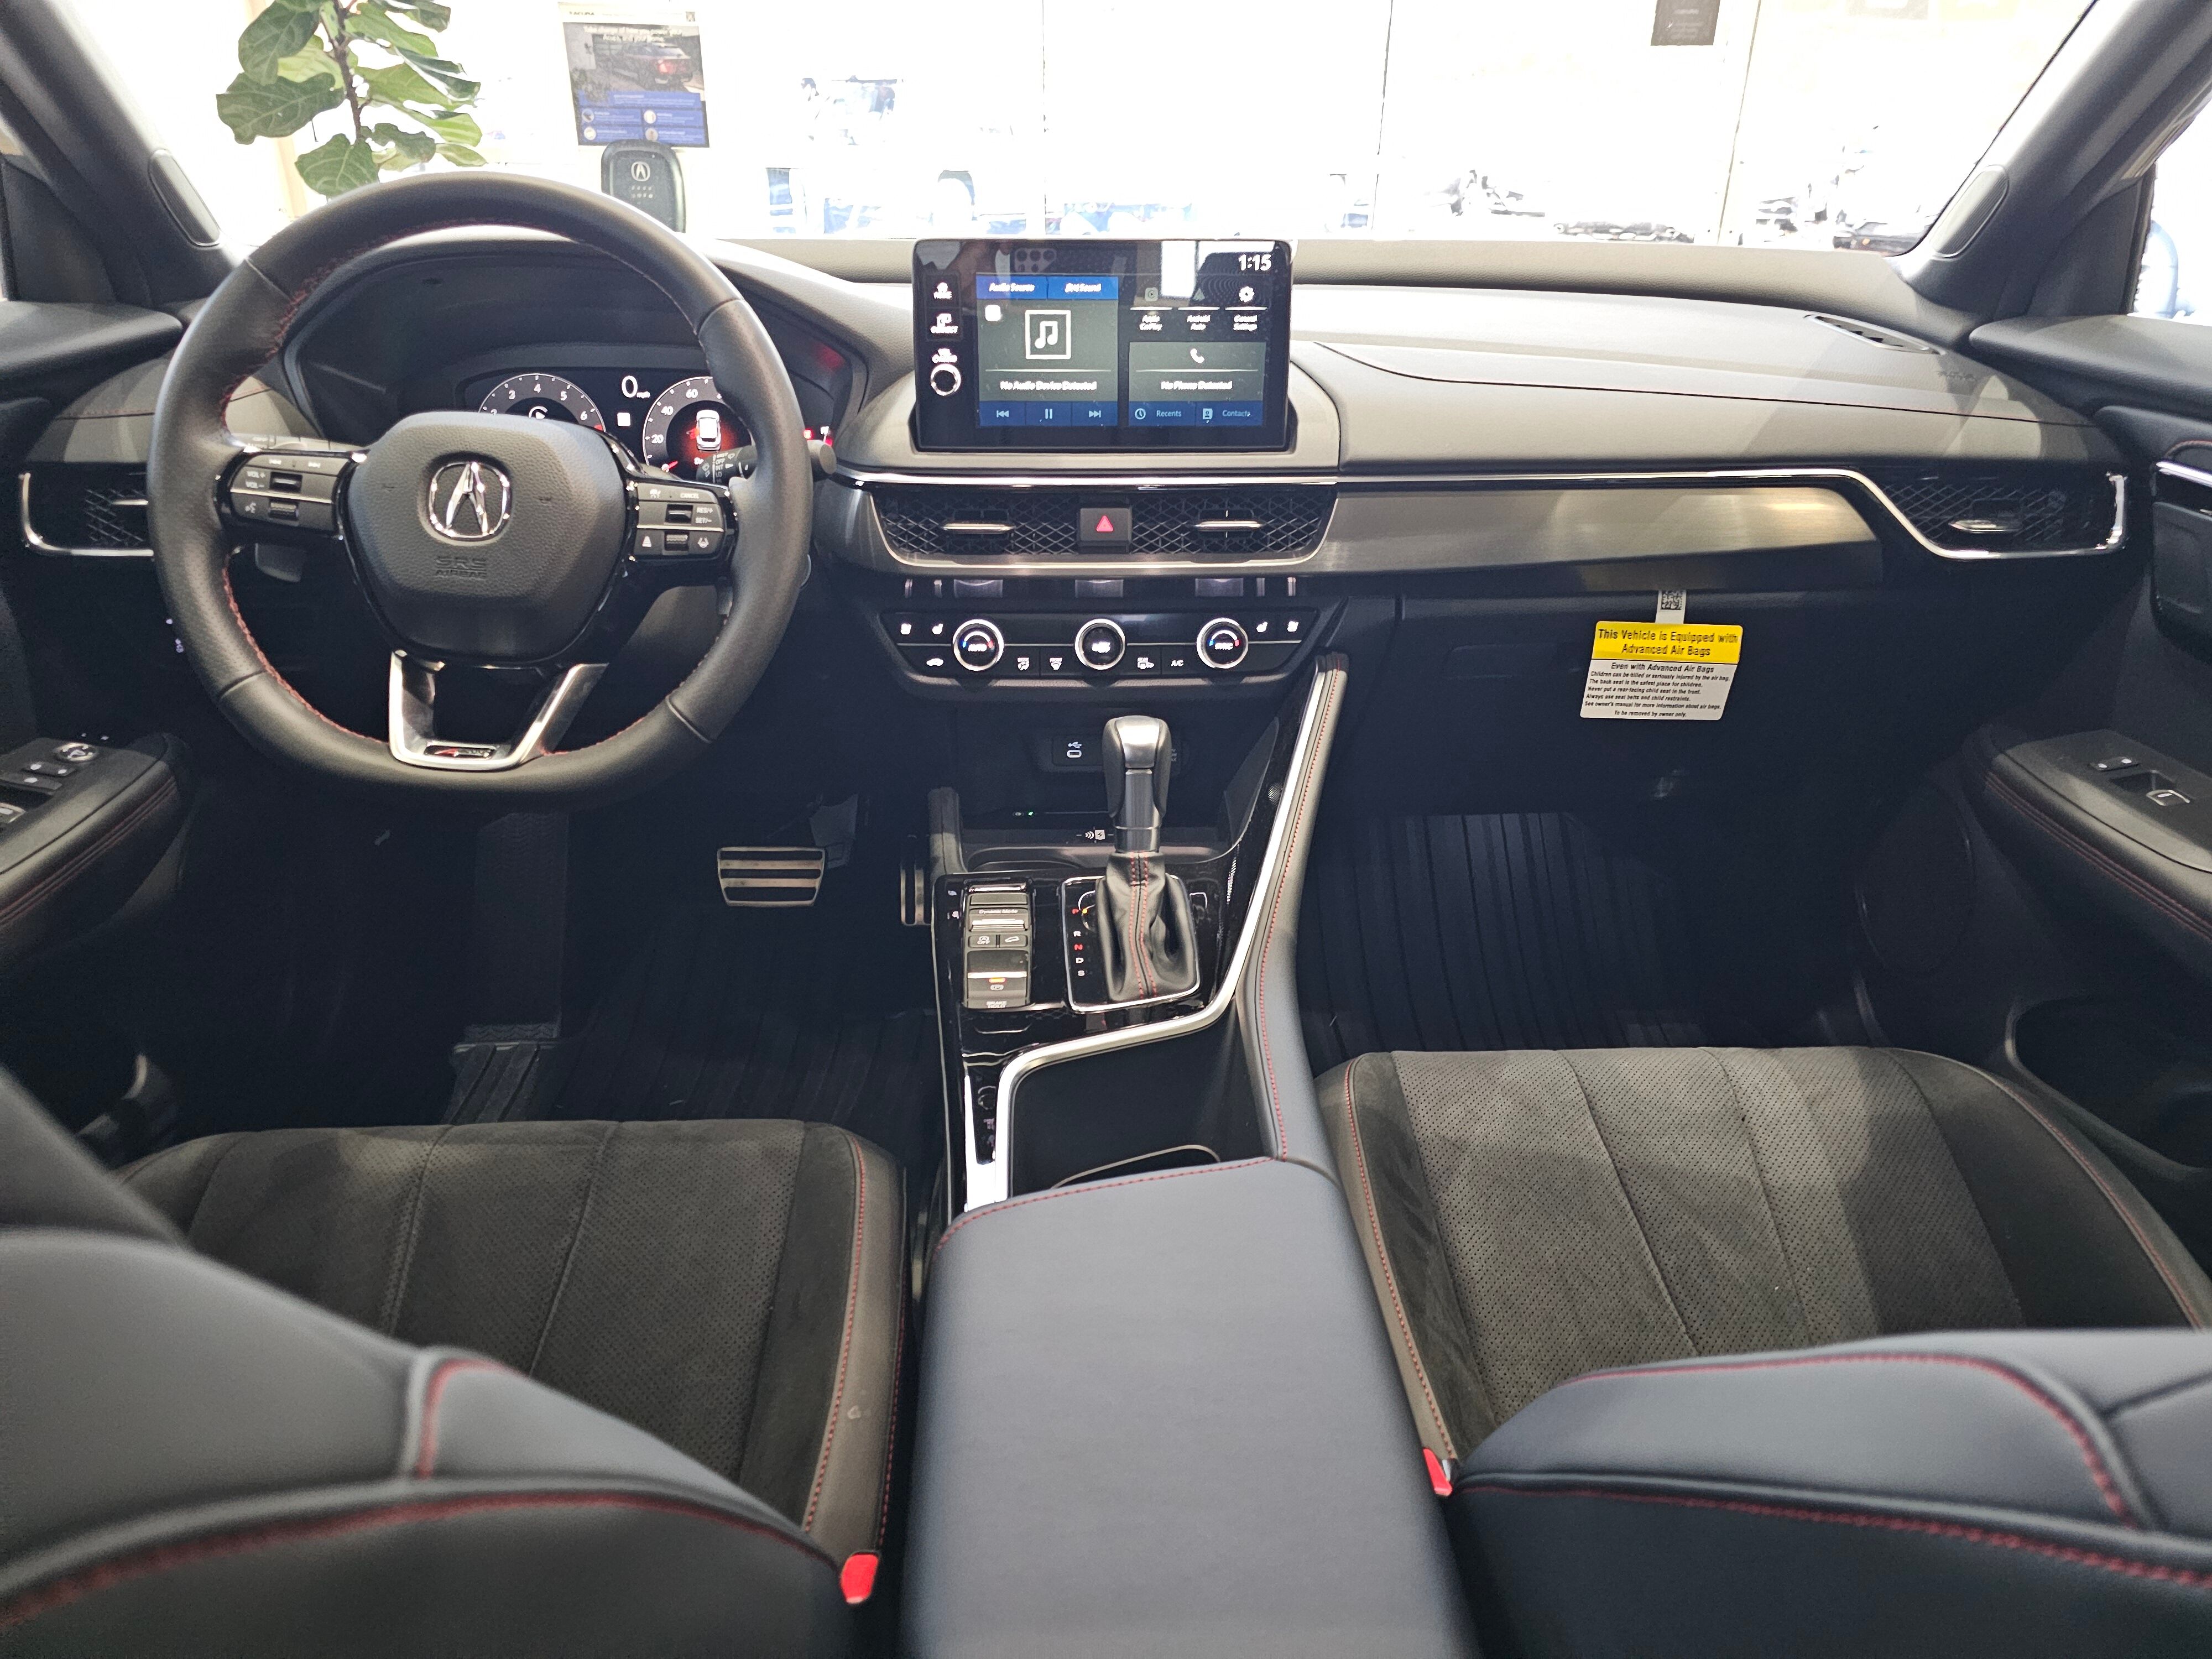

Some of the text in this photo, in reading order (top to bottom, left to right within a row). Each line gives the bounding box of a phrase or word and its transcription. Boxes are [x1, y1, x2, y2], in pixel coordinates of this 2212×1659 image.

[1238, 254, 1271, 271] 1:15
[534, 383, 541, 393] 4
[622, 375, 638, 398] 0
[1000, 381, 1097, 390] No Audio Device Detected
[1161, 381, 1232, 389] No Phone Detected
[508, 390, 516, 400] 3
[560, 390, 567, 401] 5
[686, 388, 698, 398] 60
[661, 406, 674, 415] 40
[580, 411, 588, 421] 6
[651, 434, 664, 444] 20
[436, 556, 487, 571] SRS
[435, 569, 487, 579] AIRBAG
[1598, 629, 1738, 644] This Vehicle is Equipped with
[1621, 644, 1710, 657] Advanced Air Bags
[1647, 664, 1682, 672] Advanced
